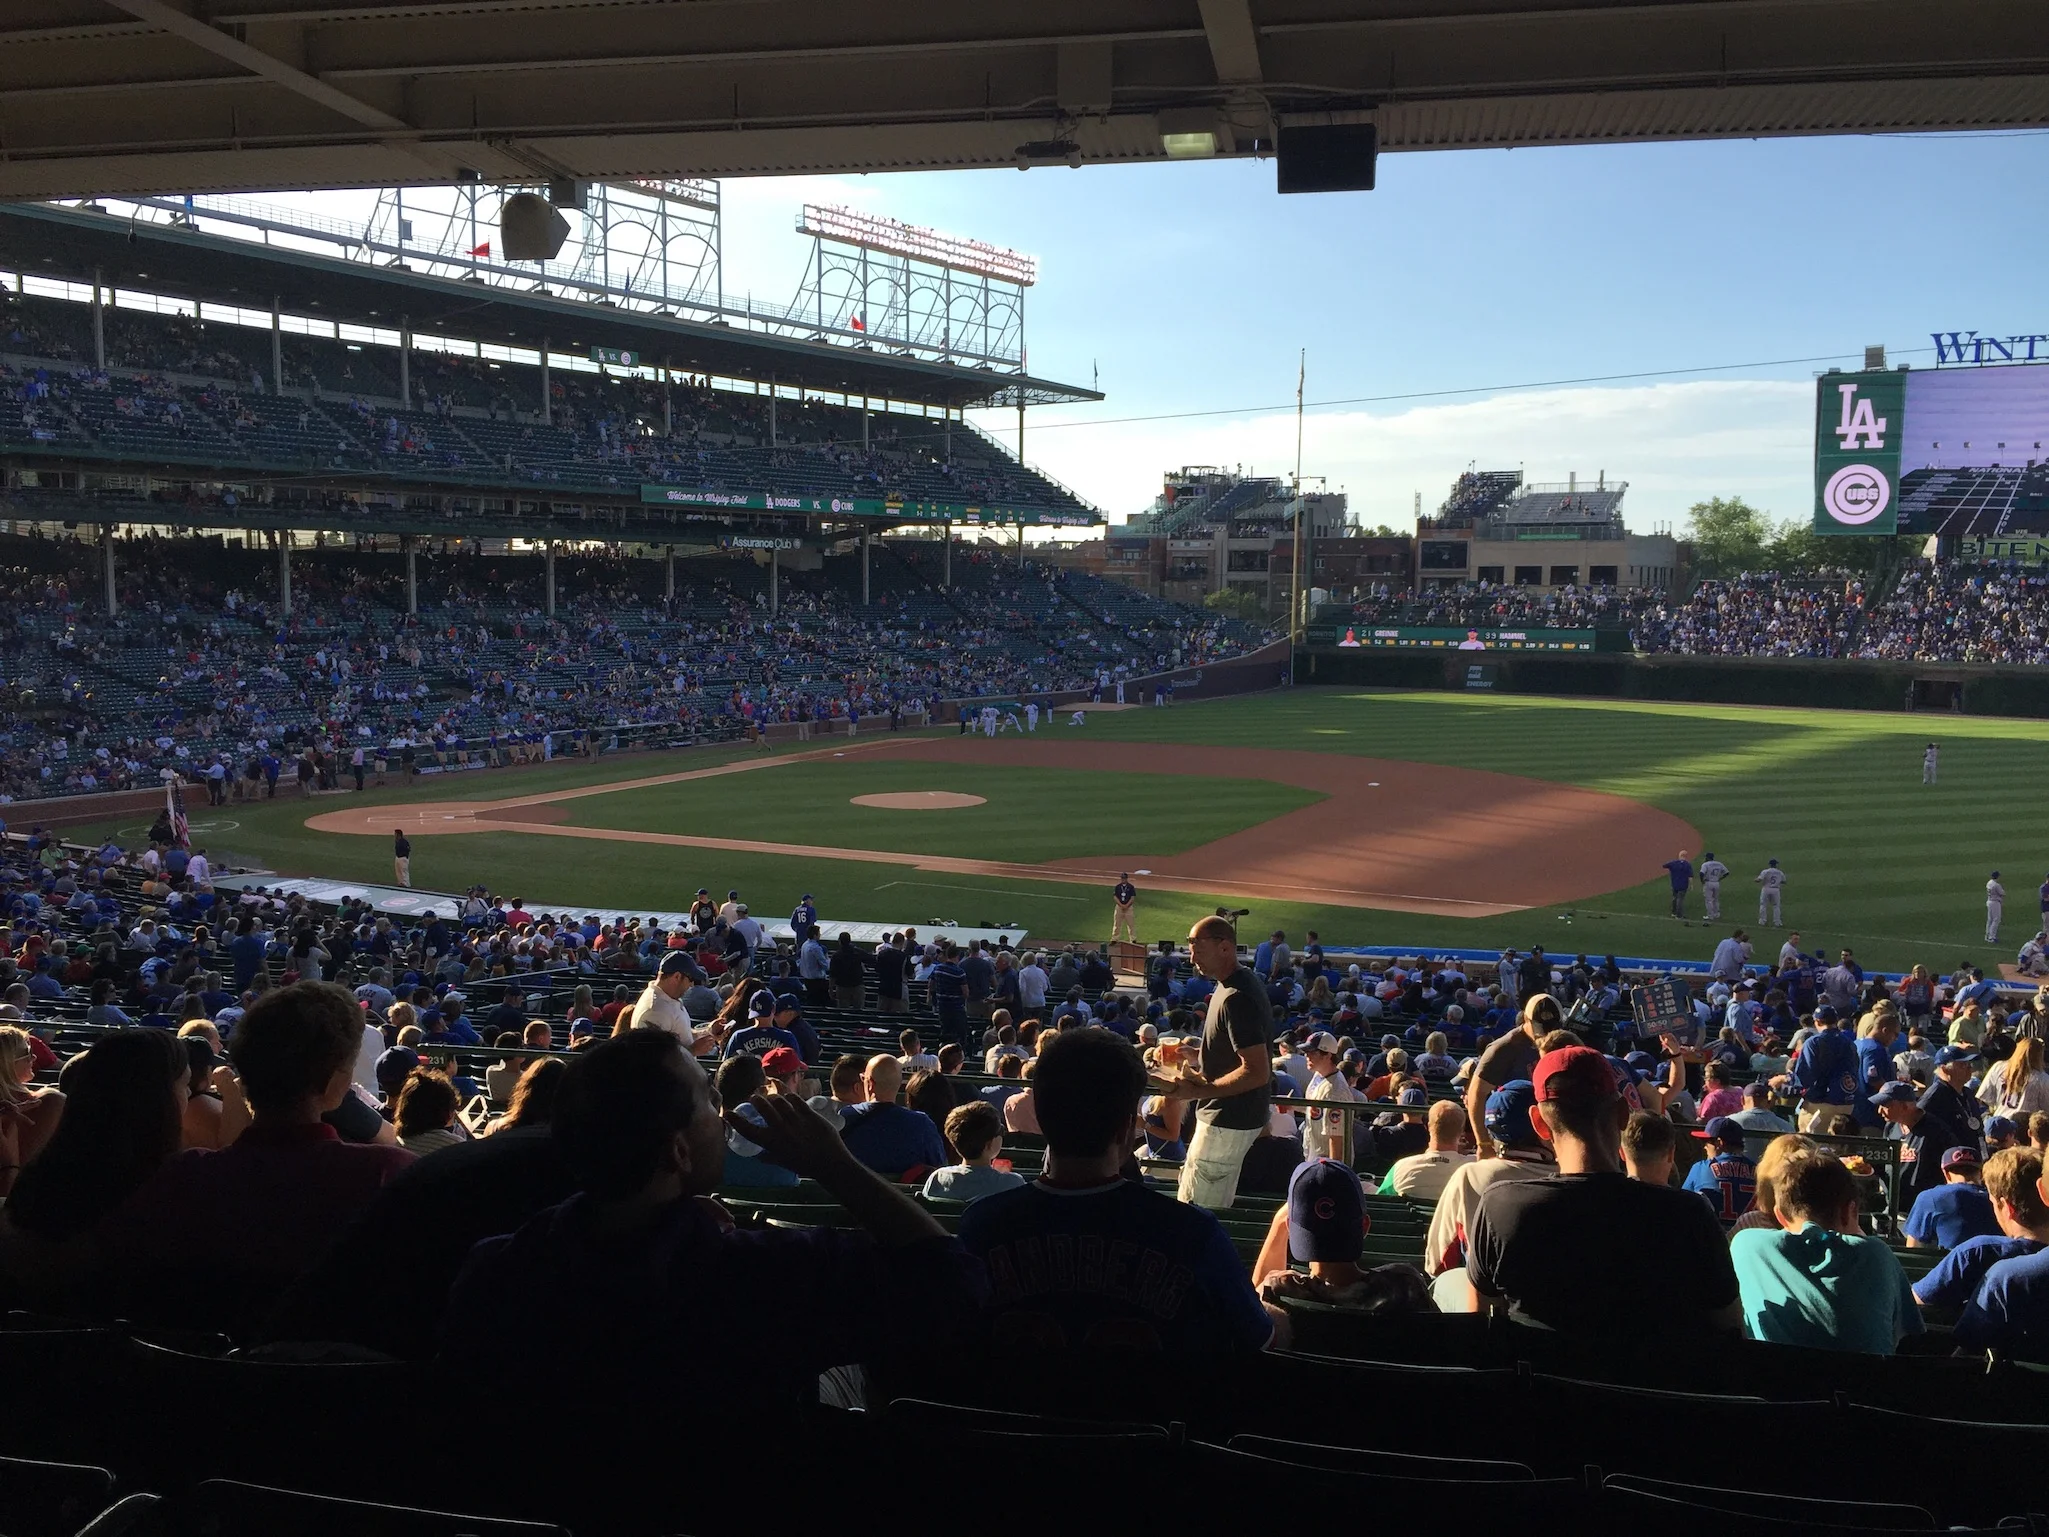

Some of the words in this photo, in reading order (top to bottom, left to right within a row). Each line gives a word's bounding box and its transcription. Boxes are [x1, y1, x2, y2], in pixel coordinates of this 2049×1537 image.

[1930, 331, 2049, 364] WINT
[1836, 384, 1886, 450] LA
[666, 490, 696, 501] Welcome
[704, 493, 730, 506] Wrigley
[730, 495, 748, 505] Field
[775, 498, 801, 508] DODGERS
[841, 502, 854, 511] CUBS
[732, 536, 774, 548] Assurance
[774, 538, 792, 549] Club
[797, 912, 807, 923] 16
[743, 1037, 784, 1052] KERSHAW
[429, 1056, 444, 1064] 231
[1866, 1151, 1888, 1160] 233
[1719, 1181, 1757, 1220] 17
[1314, 1197, 1336, 1220] C
[989, 1234, 1195, 1320] ANDBERG
